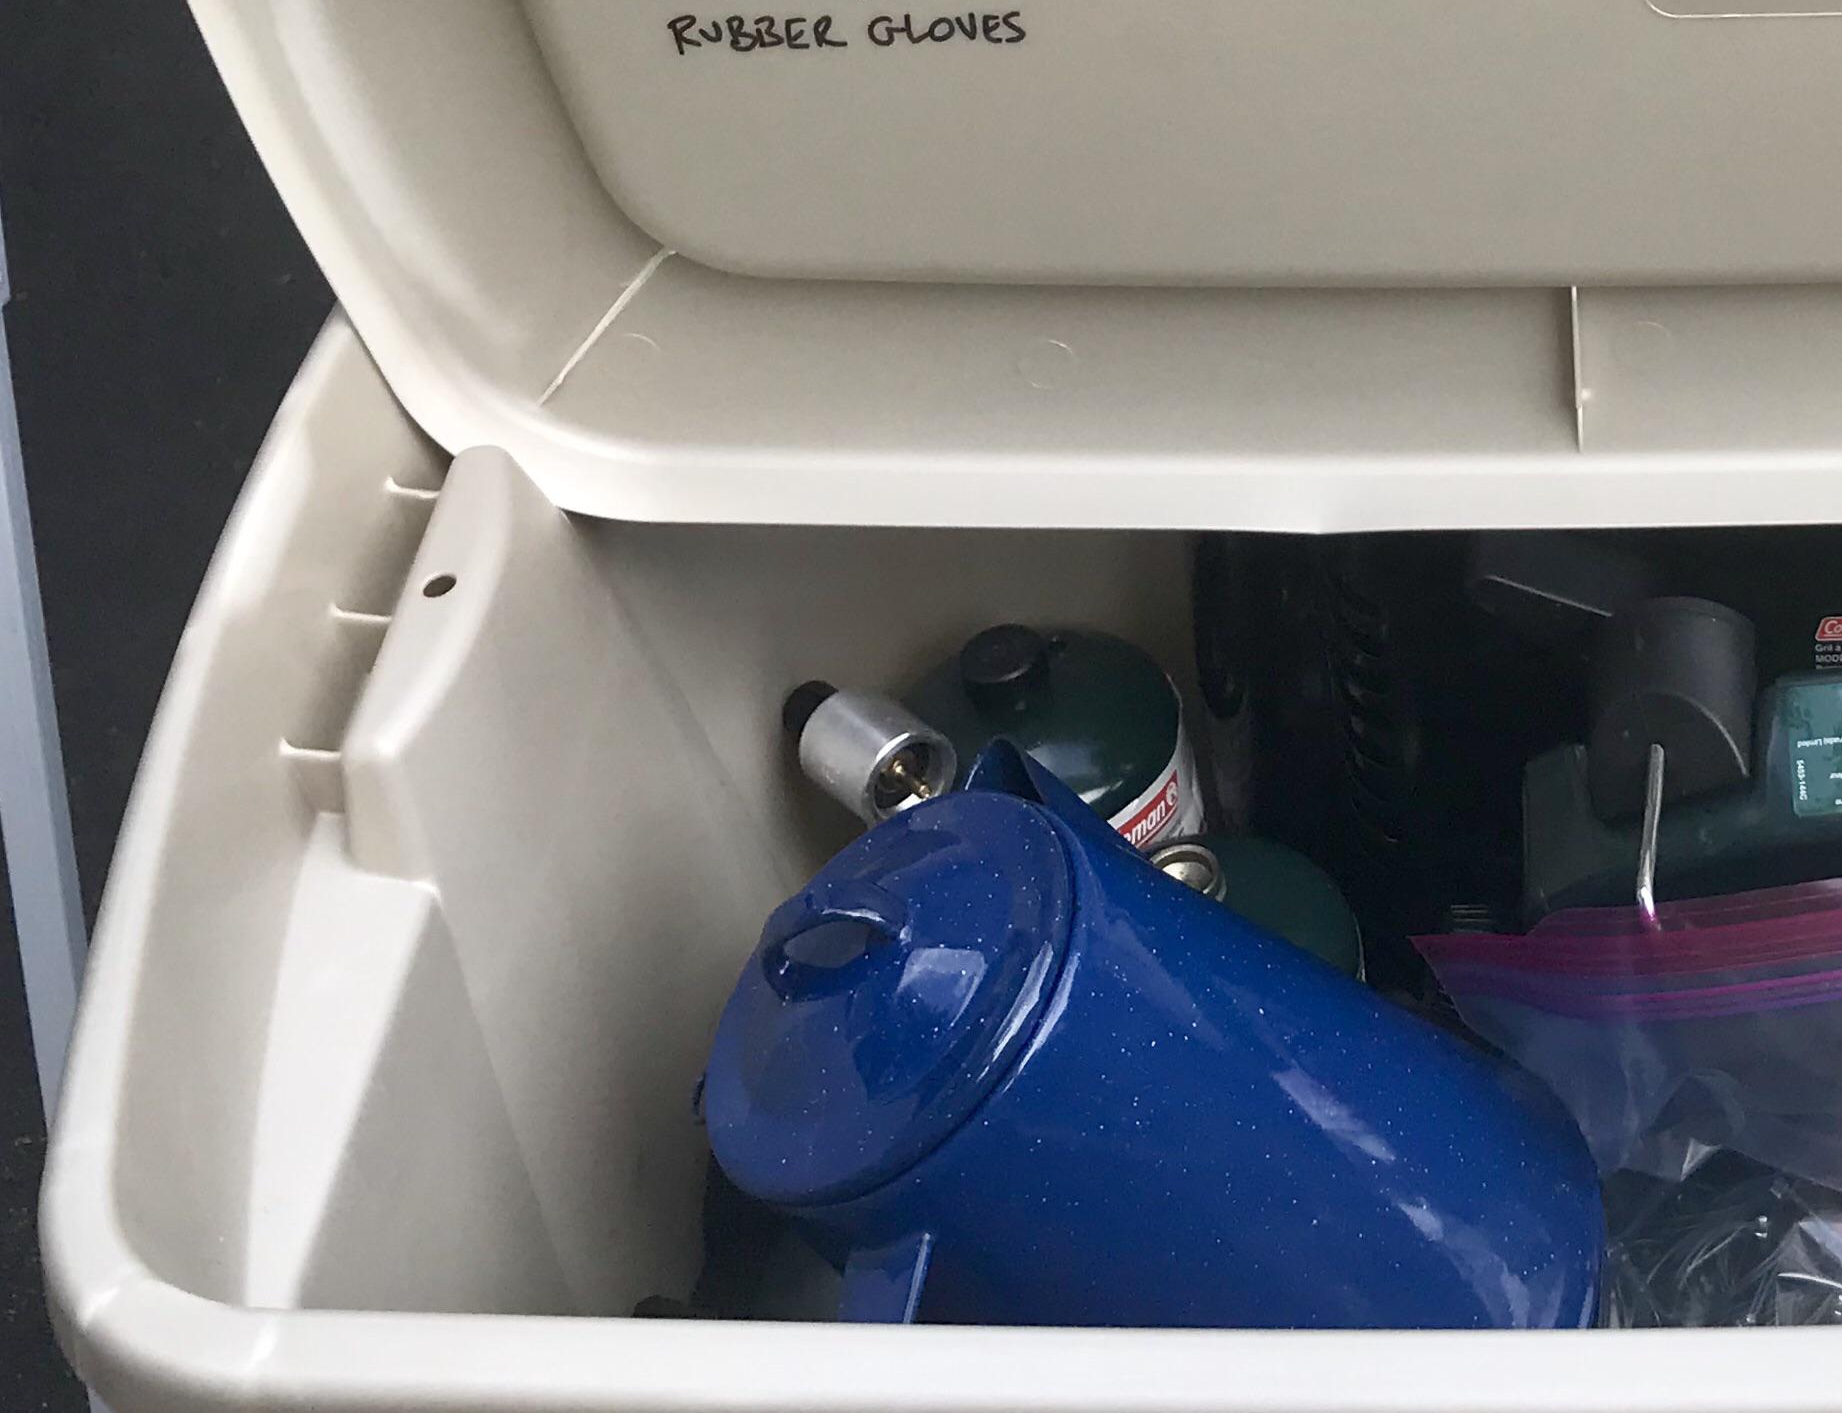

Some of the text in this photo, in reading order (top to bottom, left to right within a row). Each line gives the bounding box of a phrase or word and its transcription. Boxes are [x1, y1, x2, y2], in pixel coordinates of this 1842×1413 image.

[667, 11, 1026, 55] RUBBER GLOVES
[1122, 800, 1166, 845] man
